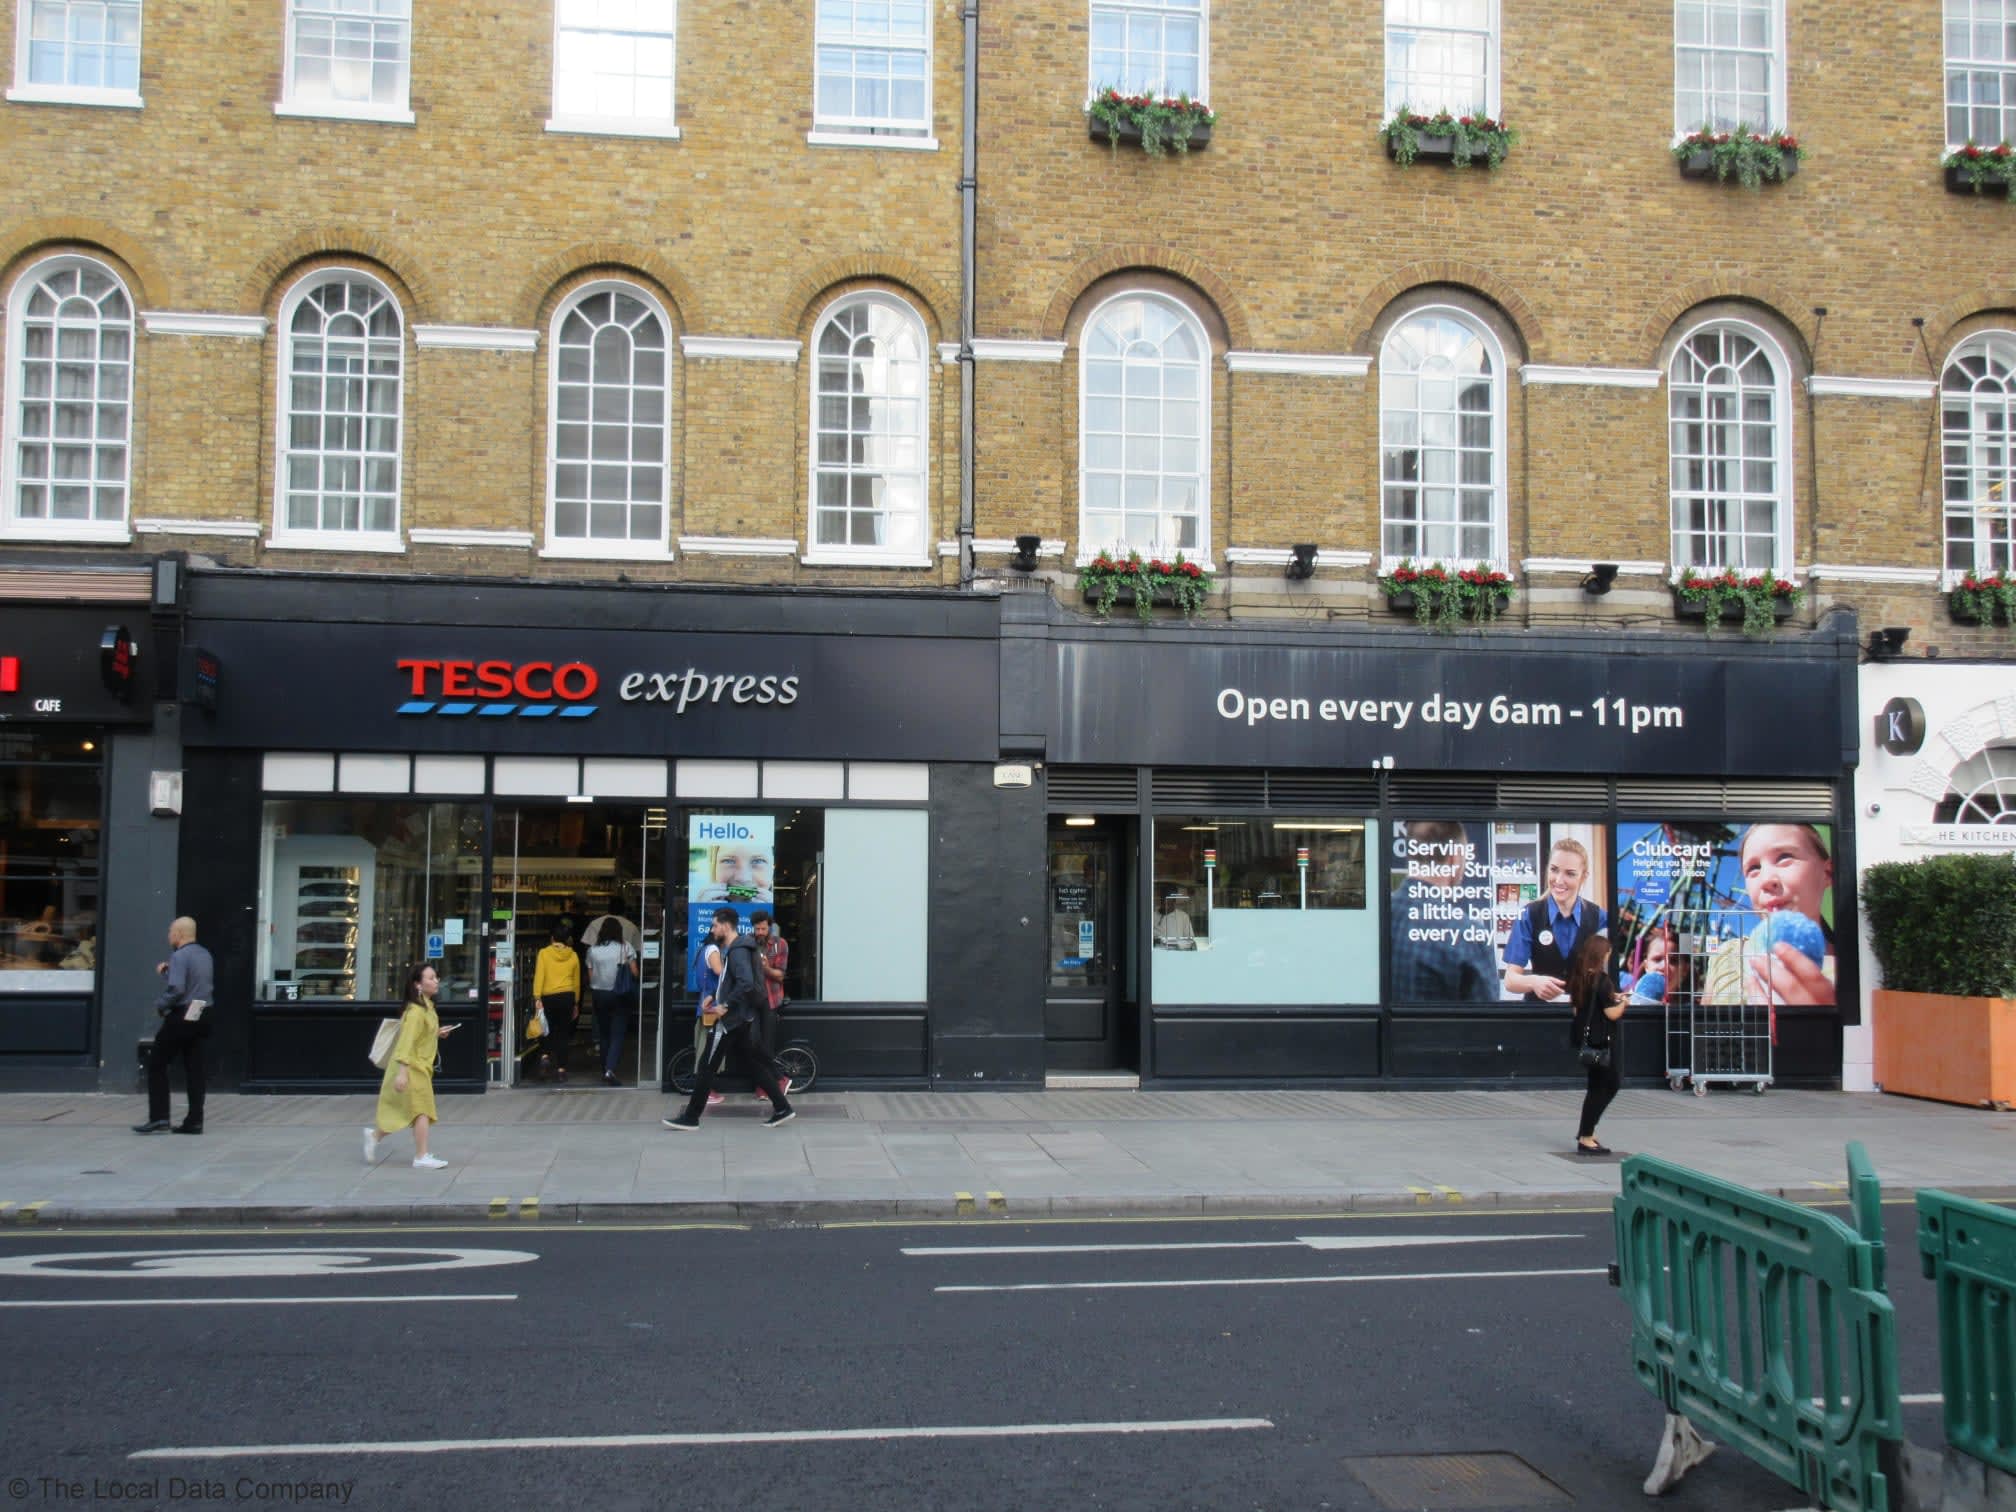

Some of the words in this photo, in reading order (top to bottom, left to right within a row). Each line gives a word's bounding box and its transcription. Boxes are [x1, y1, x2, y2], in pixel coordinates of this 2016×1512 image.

[397, 659, 599, 700] TESCO
[620, 667, 799, 714] express
[35, 699, 61, 712] CAFE
[1216, 688, 1309, 726] Open
[1319, 699, 1413, 729] every
[1421, 693, 1482, 730] day
[1489, 696, 1560, 725] 6am
[1592, 697, 1683, 733] 11pm
[1888, 711, 1905, 741] K
[699, 822, 754, 840] Hello.
[1408, 839, 1476, 860] Serving
[1633, 841, 1711, 857] Clubcard
[1408, 861, 1459, 877] Baker
[1465, 861, 1534, 878] Street's
[1633, 858, 1664, 869] Helping
[1665, 860, 1680, 869] you
[1633, 868, 1654, 877] most
[1655, 869, 1671, 877] out
[1671, 868, 1680, 877] of
[1408, 881, 1493, 903] shoppers
[1408, 908, 1419, 920] a
[1423, 903, 1463, 920] little
[1469, 903, 1527, 920] better
[1408, 927, 1459, 945] every
[1463, 925, 1495, 946] day
